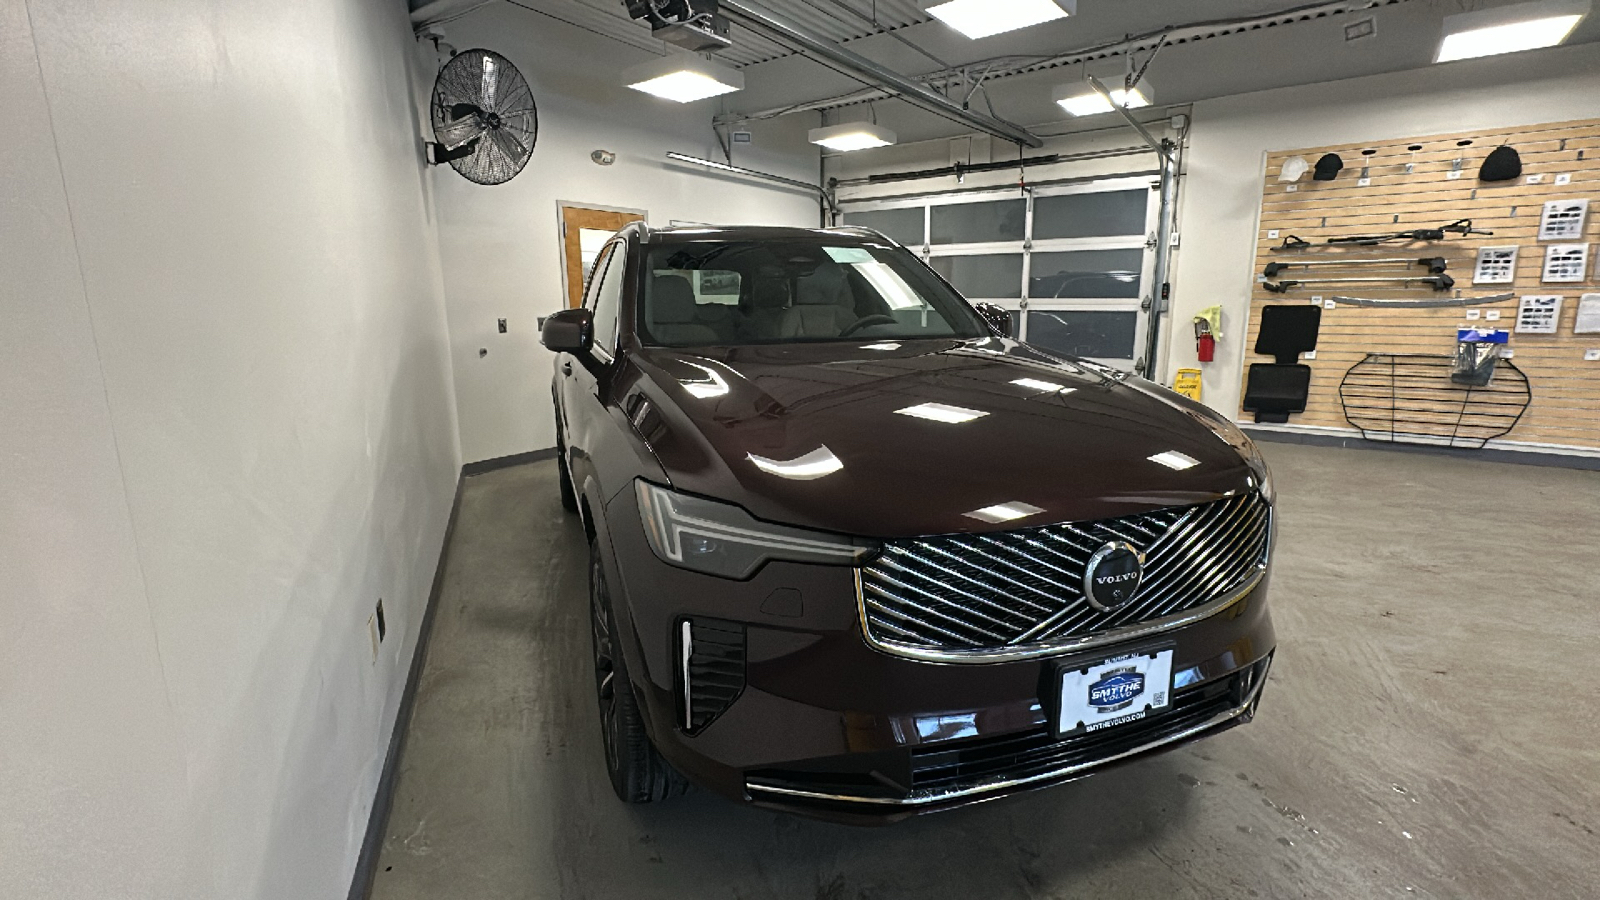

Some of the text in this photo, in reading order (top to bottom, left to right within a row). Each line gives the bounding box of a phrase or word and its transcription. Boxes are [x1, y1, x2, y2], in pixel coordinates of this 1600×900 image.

[1096, 572, 1137, 584] VOLVO
[1091, 681, 1141, 700] SMYTHE
[1103, 691, 1133, 703] VOLVO
[1086, 712, 1146, 733] SMYTHEVOLVO.COM
